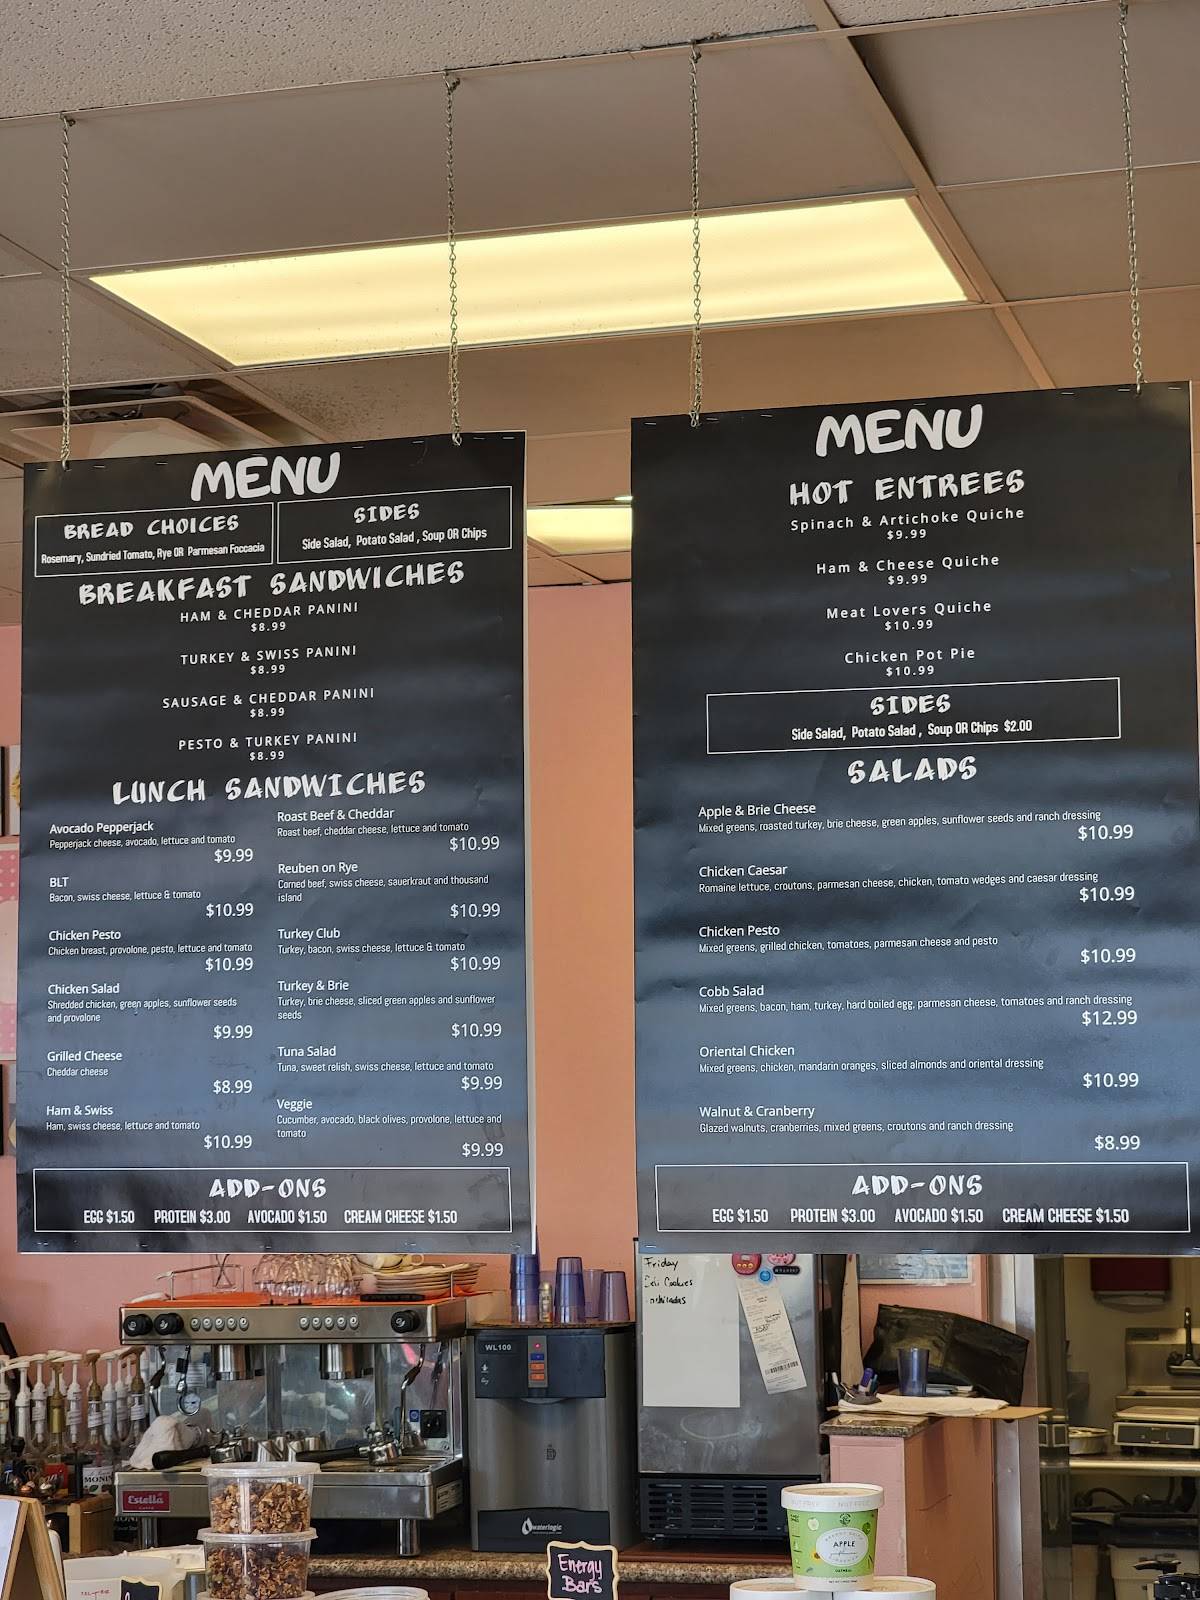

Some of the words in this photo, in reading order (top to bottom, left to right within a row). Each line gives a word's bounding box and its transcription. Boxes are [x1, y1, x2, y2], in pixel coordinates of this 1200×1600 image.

[816, 404, 983, 457] MENU
[191, 452, 341, 502] MENU
[789, 479, 853, 506] HOT
[875, 469, 1024, 501] ENTREES
[353, 503, 419, 523] SIDES
[790, 516, 853, 533] Spinach
[861, 515, 872, 527] &
[879, 511, 958, 526] Artichoke
[966, 507, 1024, 523] Quiche
[63, 521, 133, 539] BREAD
[146, 514, 239, 535] CHOICES
[887, 528, 926, 540] $9.99
[41, 553, 84, 564] Rosemary,
[85, 550, 121, 562] Sundried
[122, 549, 155, 560] Tomato,
[156, 547, 172, 560] Rye
[173, 546, 184, 557] OR
[187, 545, 228, 556] Parmesan
[229, 542, 265, 553] Foccacia
[79, 574, 251, 605] BREAKFAST
[270, 560, 464, 595] SANDWICHES
[180, 610, 210, 622] HAM
[217, 609, 226, 620] &
[233, 605, 300, 619] CHEDDAR
[308, 602, 357, 615] PANINI
[251, 621, 285, 632] $8.99
[180, 651, 234, 664] TURKEY
[240, 651, 249, 661] &
[256, 648, 299, 661] SWISS
[306, 645, 355, 658] PANINI
[844, 650, 907, 663] Chicken
[916, 649, 942, 660] Pot
[950, 647, 974, 659] Pie
[250, 663, 285, 675] $8.99
[886, 665, 934, 677] $10.99
[870, 693, 950, 715] SIDES
[847, 755, 976, 784] SALADS
[112, 778, 205, 805] LUNCH
[225, 770, 425, 800] SANDWICHES
[277, 811, 308, 822] Roast
[309, 809, 335, 821] Beef
[336, 809, 345, 820] &
[347, 807, 395, 819] Cheddar
[697, 805, 732, 820] Apple
[734, 804, 744, 816] &
[747, 804, 770, 815] Brie
[773, 803, 816, 814] Cheese
[49, 822, 94, 834] Avocado
[96, 820, 153, 835] Pepperjack
[277, 827, 300, 836] Roast
[302, 826, 322, 837] beef,
[323, 825, 356, 835] cheddar
[357, 824, 388, 834] cheese,
[390, 824, 420, 833] lettuce
[422, 822, 437, 832] and
[438, 822, 469, 831] tomato
[1077, 824, 1133, 841] $10.99
[49, 838, 91, 850] Pepperjack
[93, 838, 123, 847] cheese,
[125, 836, 159, 846] avocado,
[160, 834, 190, 848] lettuce
[190, 834, 205, 844] and
[206, 834, 235, 843] tomato
[449, 835, 499, 852] $10.99
[214, 847, 253, 863] $9.99
[278, 862, 319, 874] Reuben
[321, 864, 336, 872] on
[338, 861, 358, 875] Rye
[698, 865, 744, 877] Chicken
[747, 864, 788, 875] Caesar
[49, 876, 69, 887] BLT
[698, 882, 736, 892] Romaine
[738, 882, 771, 891] lettuce,
[774, 881, 814, 890] croutons,
[817, 880, 860, 891] parmesan
[861, 877, 896, 888] cheese,
[898, 876, 934, 886] chicken,
[936, 876, 969, 885] tomato
[971, 874, 1006, 886] wedges
[1008, 873, 1024, 883] and
[1026, 874, 1057, 883] caesar
[1059, 871, 1098, 883] dressing
[1079, 885, 1134, 902] $10.99
[205, 902, 253, 918] $10.99
[450, 902, 500, 918] $10.99
[48, 929, 89, 941] Chicken
[92, 929, 121, 940] Pesto
[698, 925, 744, 937] Chicken
[747, 924, 780, 936] Pesto
[698, 942, 723, 952] Mixed
[725, 943, 757, 954] greens,
[759, 941, 786, 953] grilled
[788, 940, 824, 951] chicken,
[826, 939, 871, 949] tomatoes,
[873, 939, 917, 950] parmesan
[919, 936, 951, 947] cheese
[953, 935, 970, 945] and
[972, 935, 998, 948] pesto
[1080, 947, 1136, 964] $10.99
[205, 956, 253, 972] $10.99
[47, 983, 88, 994] Chicken
[90, 982, 119, 994] Salad
[277, 980, 314, 993] Turkey
[316, 979, 325, 990] &
[327, 979, 349, 990] Brie
[699, 985, 729, 997] Cobb
[732, 984, 764, 996] Salad
[47, 999, 84, 1009] Shredded
[85, 999, 117, 1009] chicken,
[119, 1000, 141, 1010] green
[143, 998, 171, 1010] apples,
[173, 997, 211, 1007] sunflower
[213, 997, 237, 1006] seeds
[47, 1013, 62, 1022] and
[63, 1012, 100, 1024] provolone
[1081, 1009, 1137, 1026] $12.99
[213, 1024, 253, 1039] $9.99
[451, 1022, 501, 1038] $10.99
[699, 1045, 746, 1057] Oriental
[749, 1044, 794, 1056] Chicken
[1082, 1072, 1139, 1088] $10.99
[276, 1098, 312, 1112] Veggie
[699, 1105, 741, 1117] Walnut
[743, 1105, 753, 1116] &
[755, 1104, 815, 1119] Cranberry
[462, 1142, 503, 1157] $9.99
[1094, 1134, 1140, 1151] $8.99
[208, 1177, 326, 1198] ADD-ONS
[851, 1174, 982, 1195] ADD-ONS
[83, 1209, 103, 1223] EGG
[105, 1208, 135, 1224] $1.50
[154, 1209, 196, 1223] PROTEIN
[199, 1208, 230, 1224] $3.00
[247, 1209, 295, 1223] AVOCADO
[297, 1208, 327, 1224] $1.50
[343, 1209, 381, 1223] CREAM
[384, 1209, 425, 1223] CHEESE
[427, 1208, 457, 1224] $1.50
[644, 1257, 678, 1271] Friday
[485, 1343, 512, 1351] WL100
[128, 1495, 164, 1504] Estella
[832, 1540, 856, 1548] APPLE
[557, 1553, 603, 1580] Energy
[561, 1575, 603, 1594] Bars
